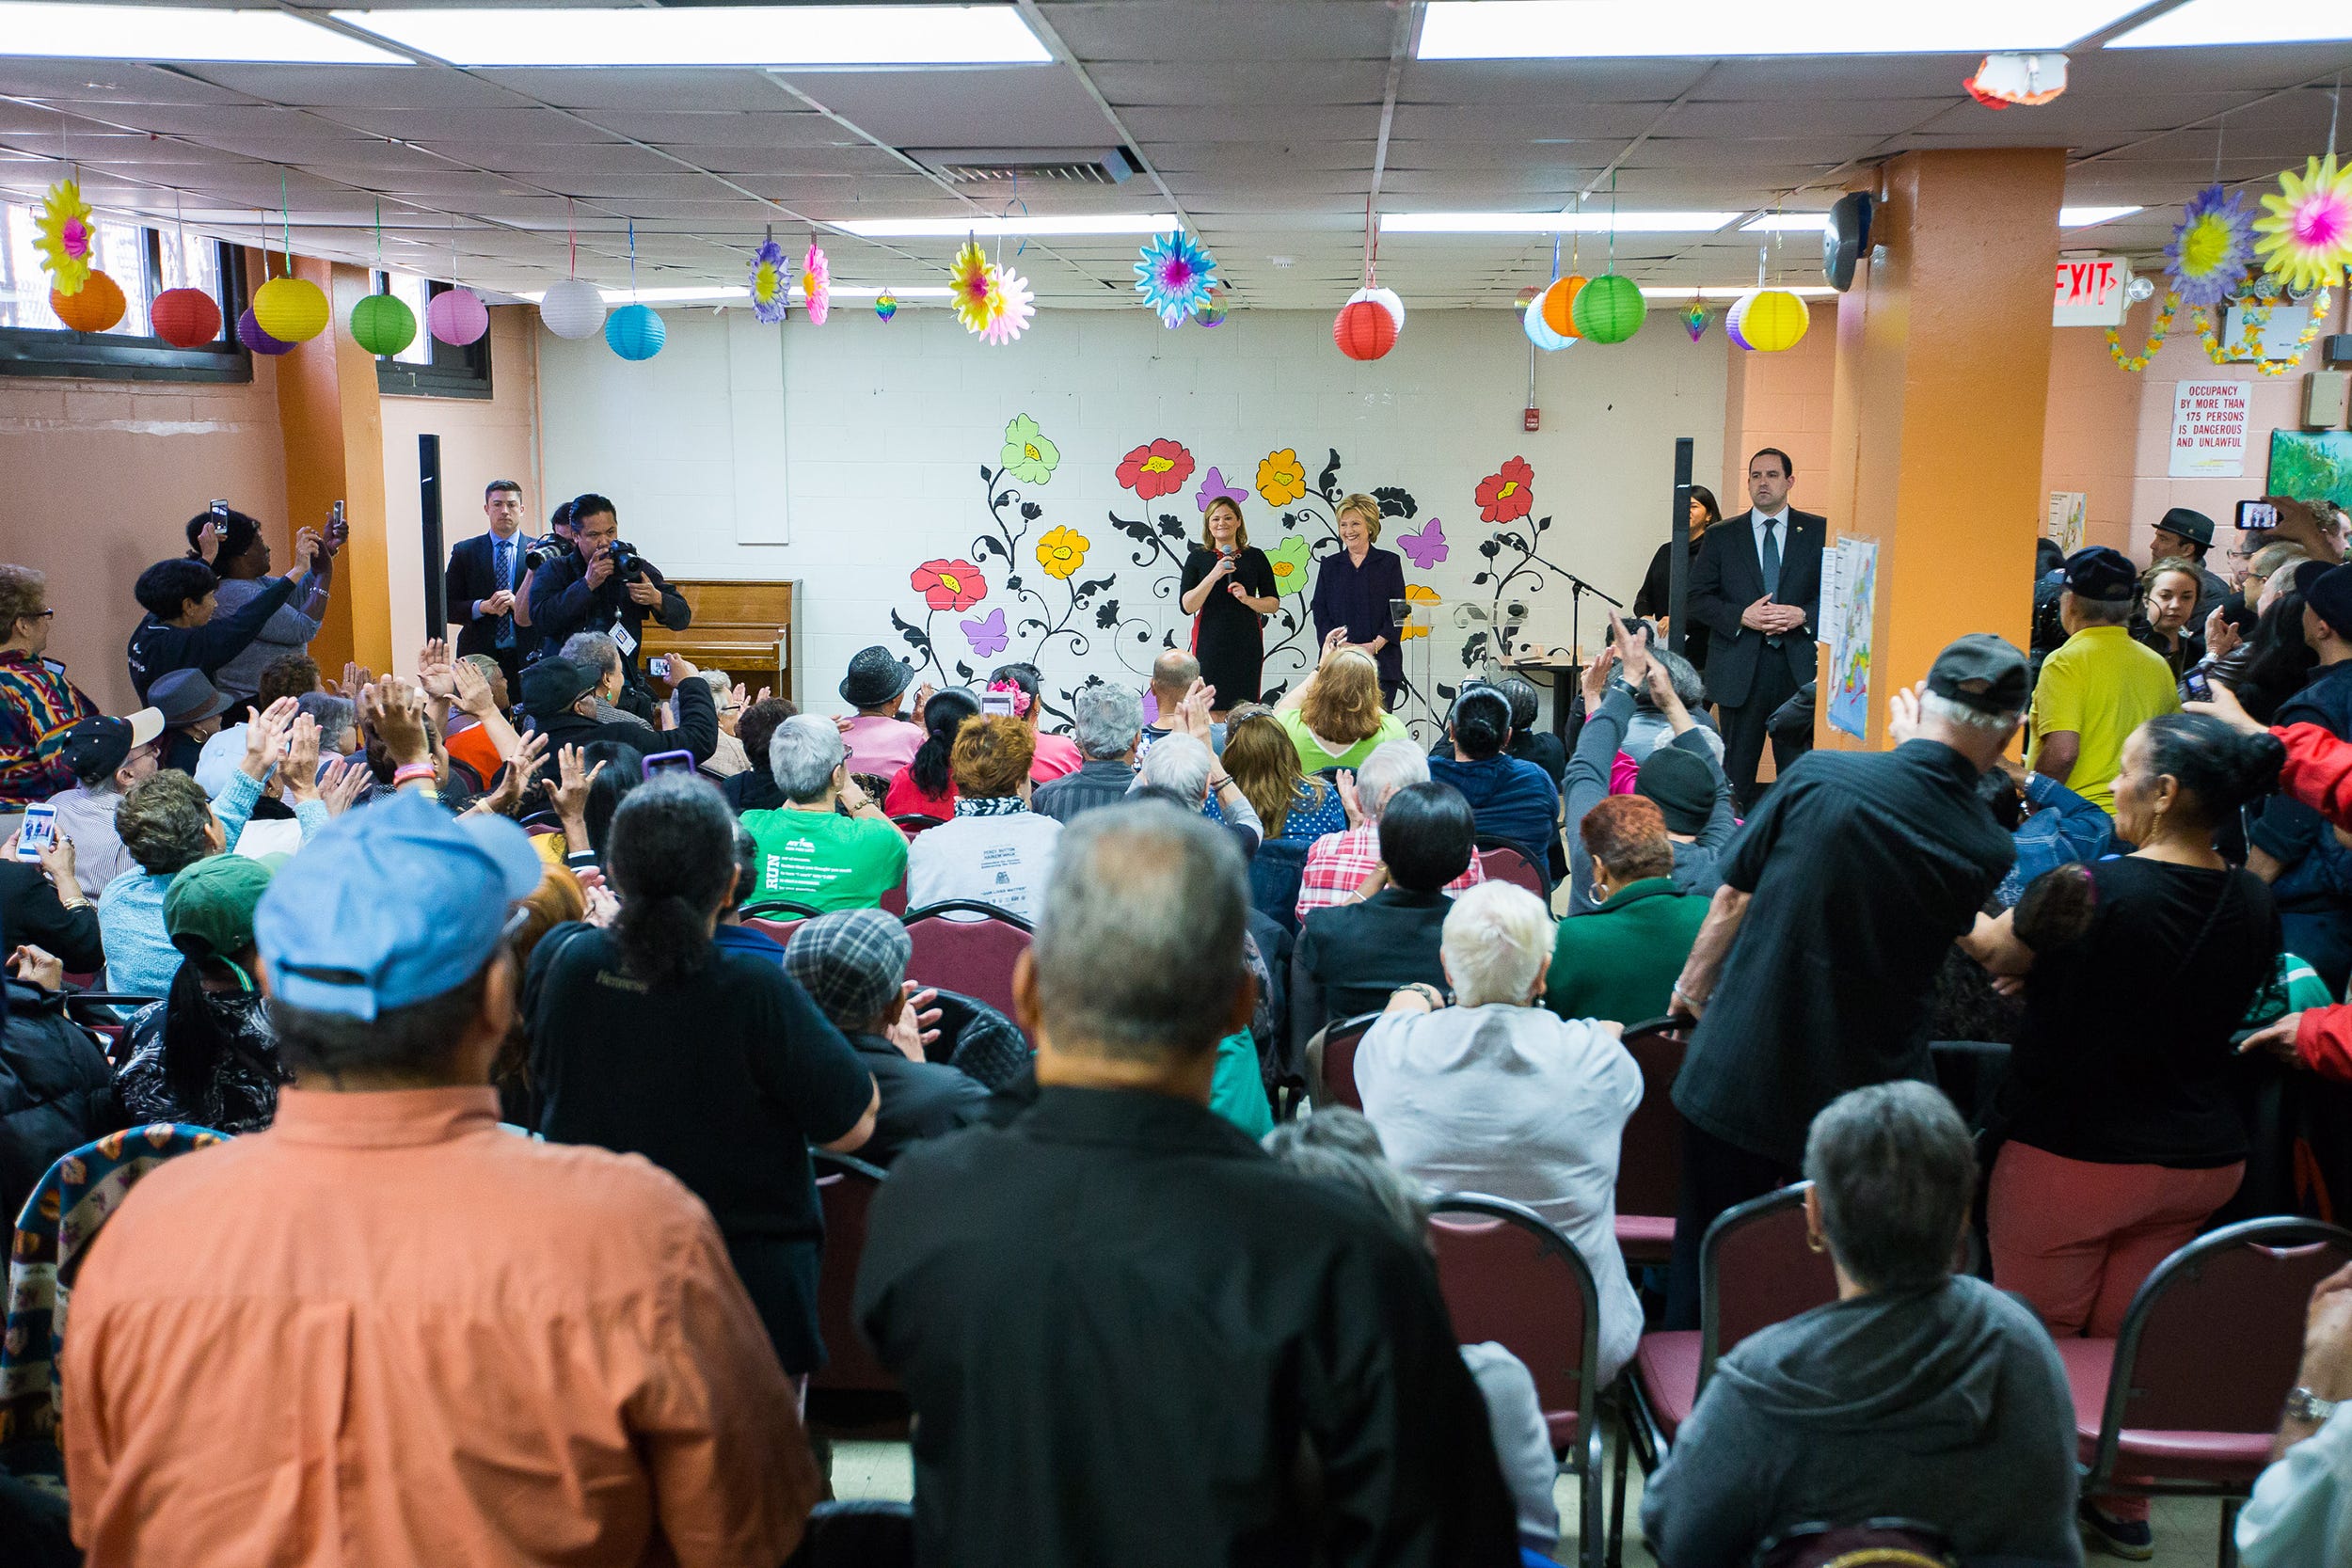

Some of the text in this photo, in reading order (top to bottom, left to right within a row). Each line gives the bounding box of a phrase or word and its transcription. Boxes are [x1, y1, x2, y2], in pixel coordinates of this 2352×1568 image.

[2054, 262, 2113, 306] EXIT
[2189, 386, 2238, 396] OCCUPANCY
[2180, 399, 2245, 408] BY MORE THAN
[2186, 411, 2245, 421] 175 PERSONS
[2179, 424, 2242, 435] IS DANGEROUS
[2176, 437, 2242, 447] AND UNLAWFUL
[766, 853, 780, 890] RUN
